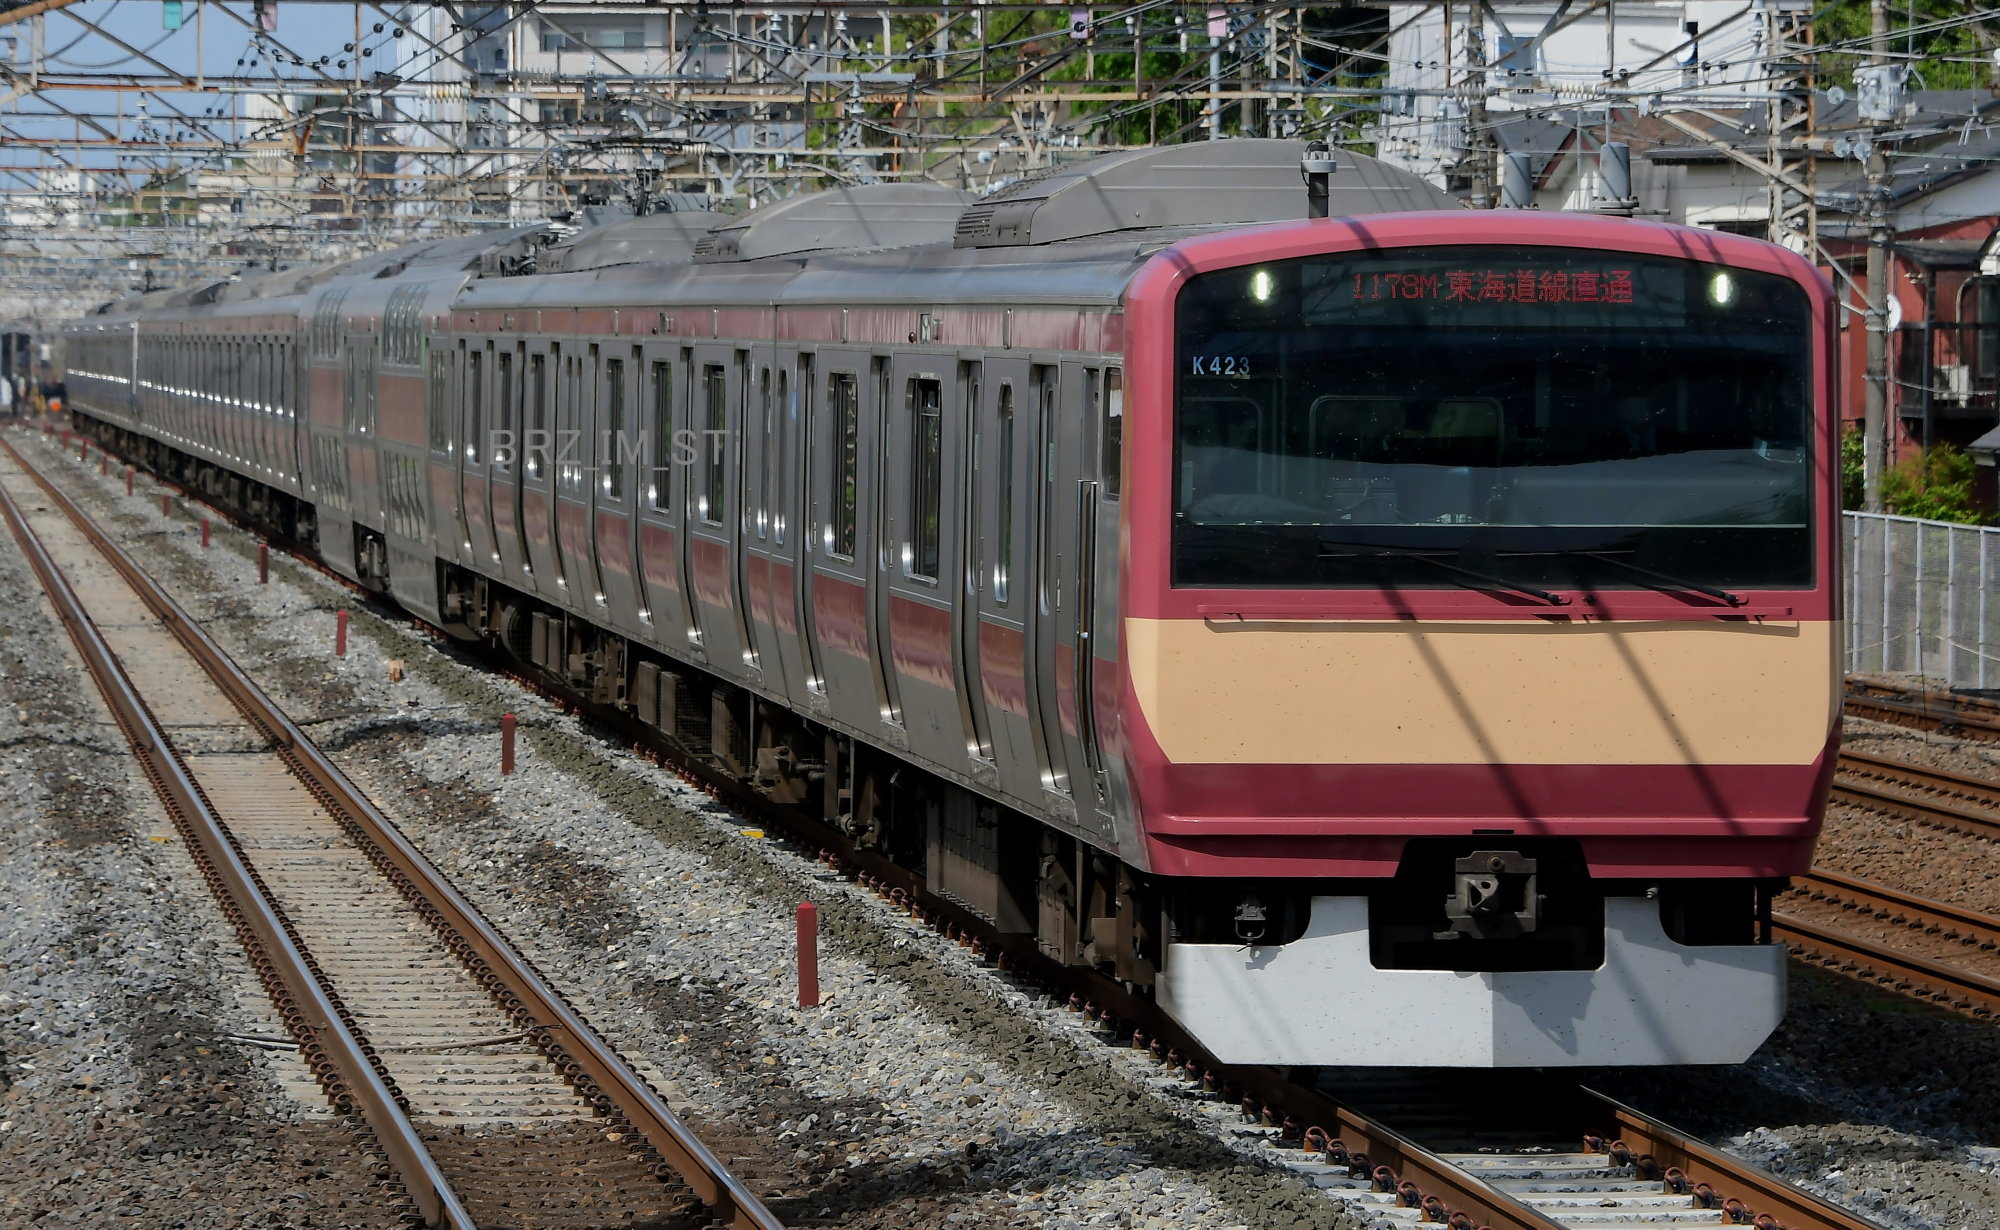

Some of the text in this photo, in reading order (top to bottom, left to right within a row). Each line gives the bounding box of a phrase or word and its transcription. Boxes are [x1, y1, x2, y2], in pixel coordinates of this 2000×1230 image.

[1352, 269, 1633, 303] 1178M 東海道線直通
[1192, 356, 1250, 375] K423
